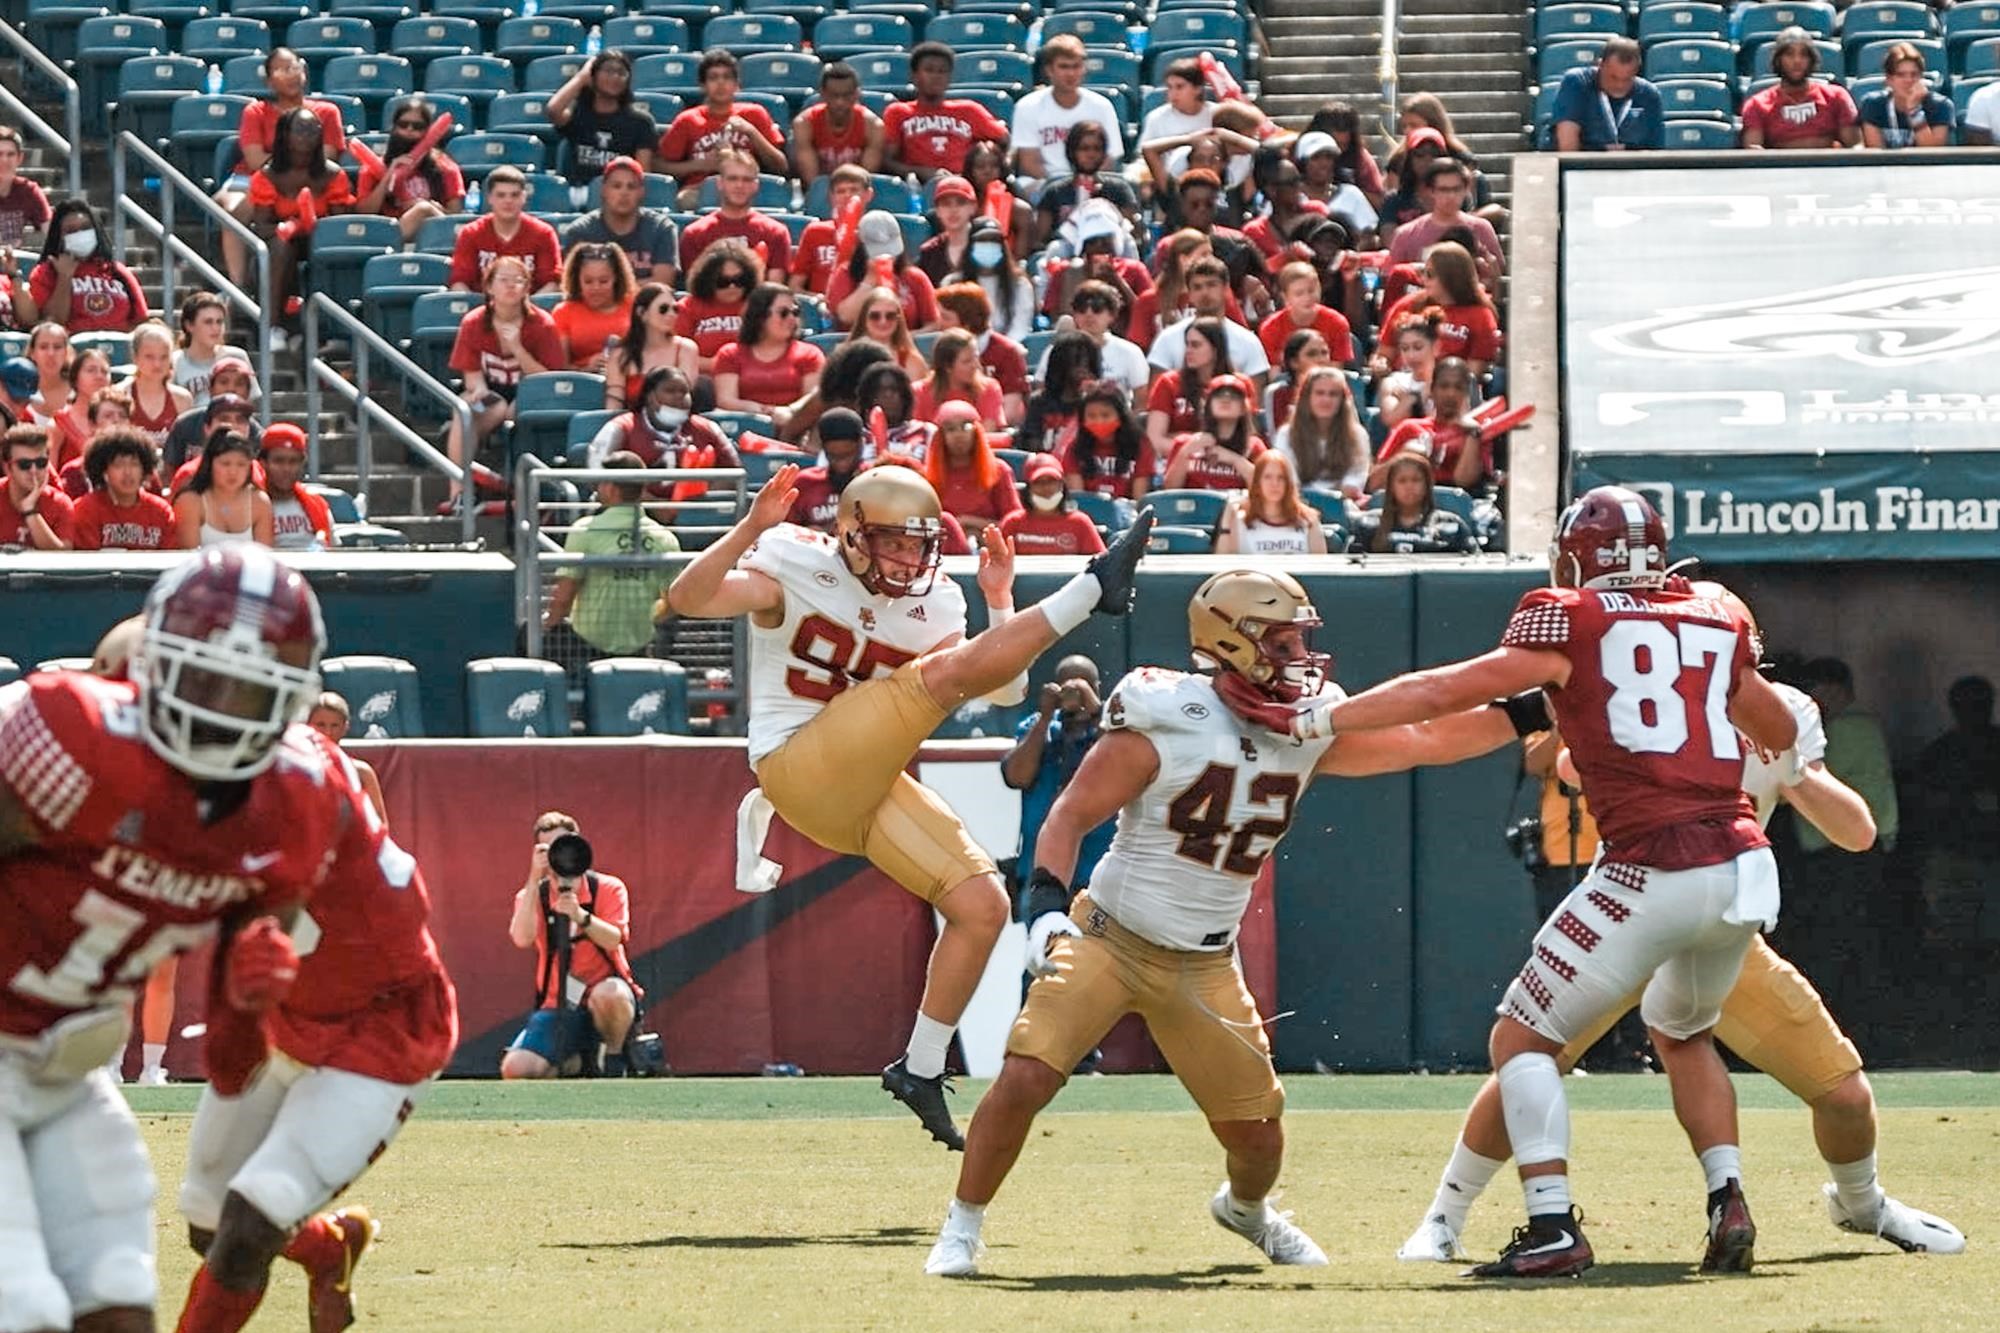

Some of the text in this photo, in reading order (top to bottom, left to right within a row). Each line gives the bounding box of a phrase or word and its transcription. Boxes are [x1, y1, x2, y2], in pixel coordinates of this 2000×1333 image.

[902, 115, 972, 138] TEMPLE
[1684, 488, 1869, 534] Lincoln
[102, 522, 162, 546] TEMPLE
[271, 515, 315, 536] EMPL
[1256, 540, 1304, 552] TEMPLE
[1599, 618, 1739, 761] 87
[1168, 761, 1301, 877] 42
